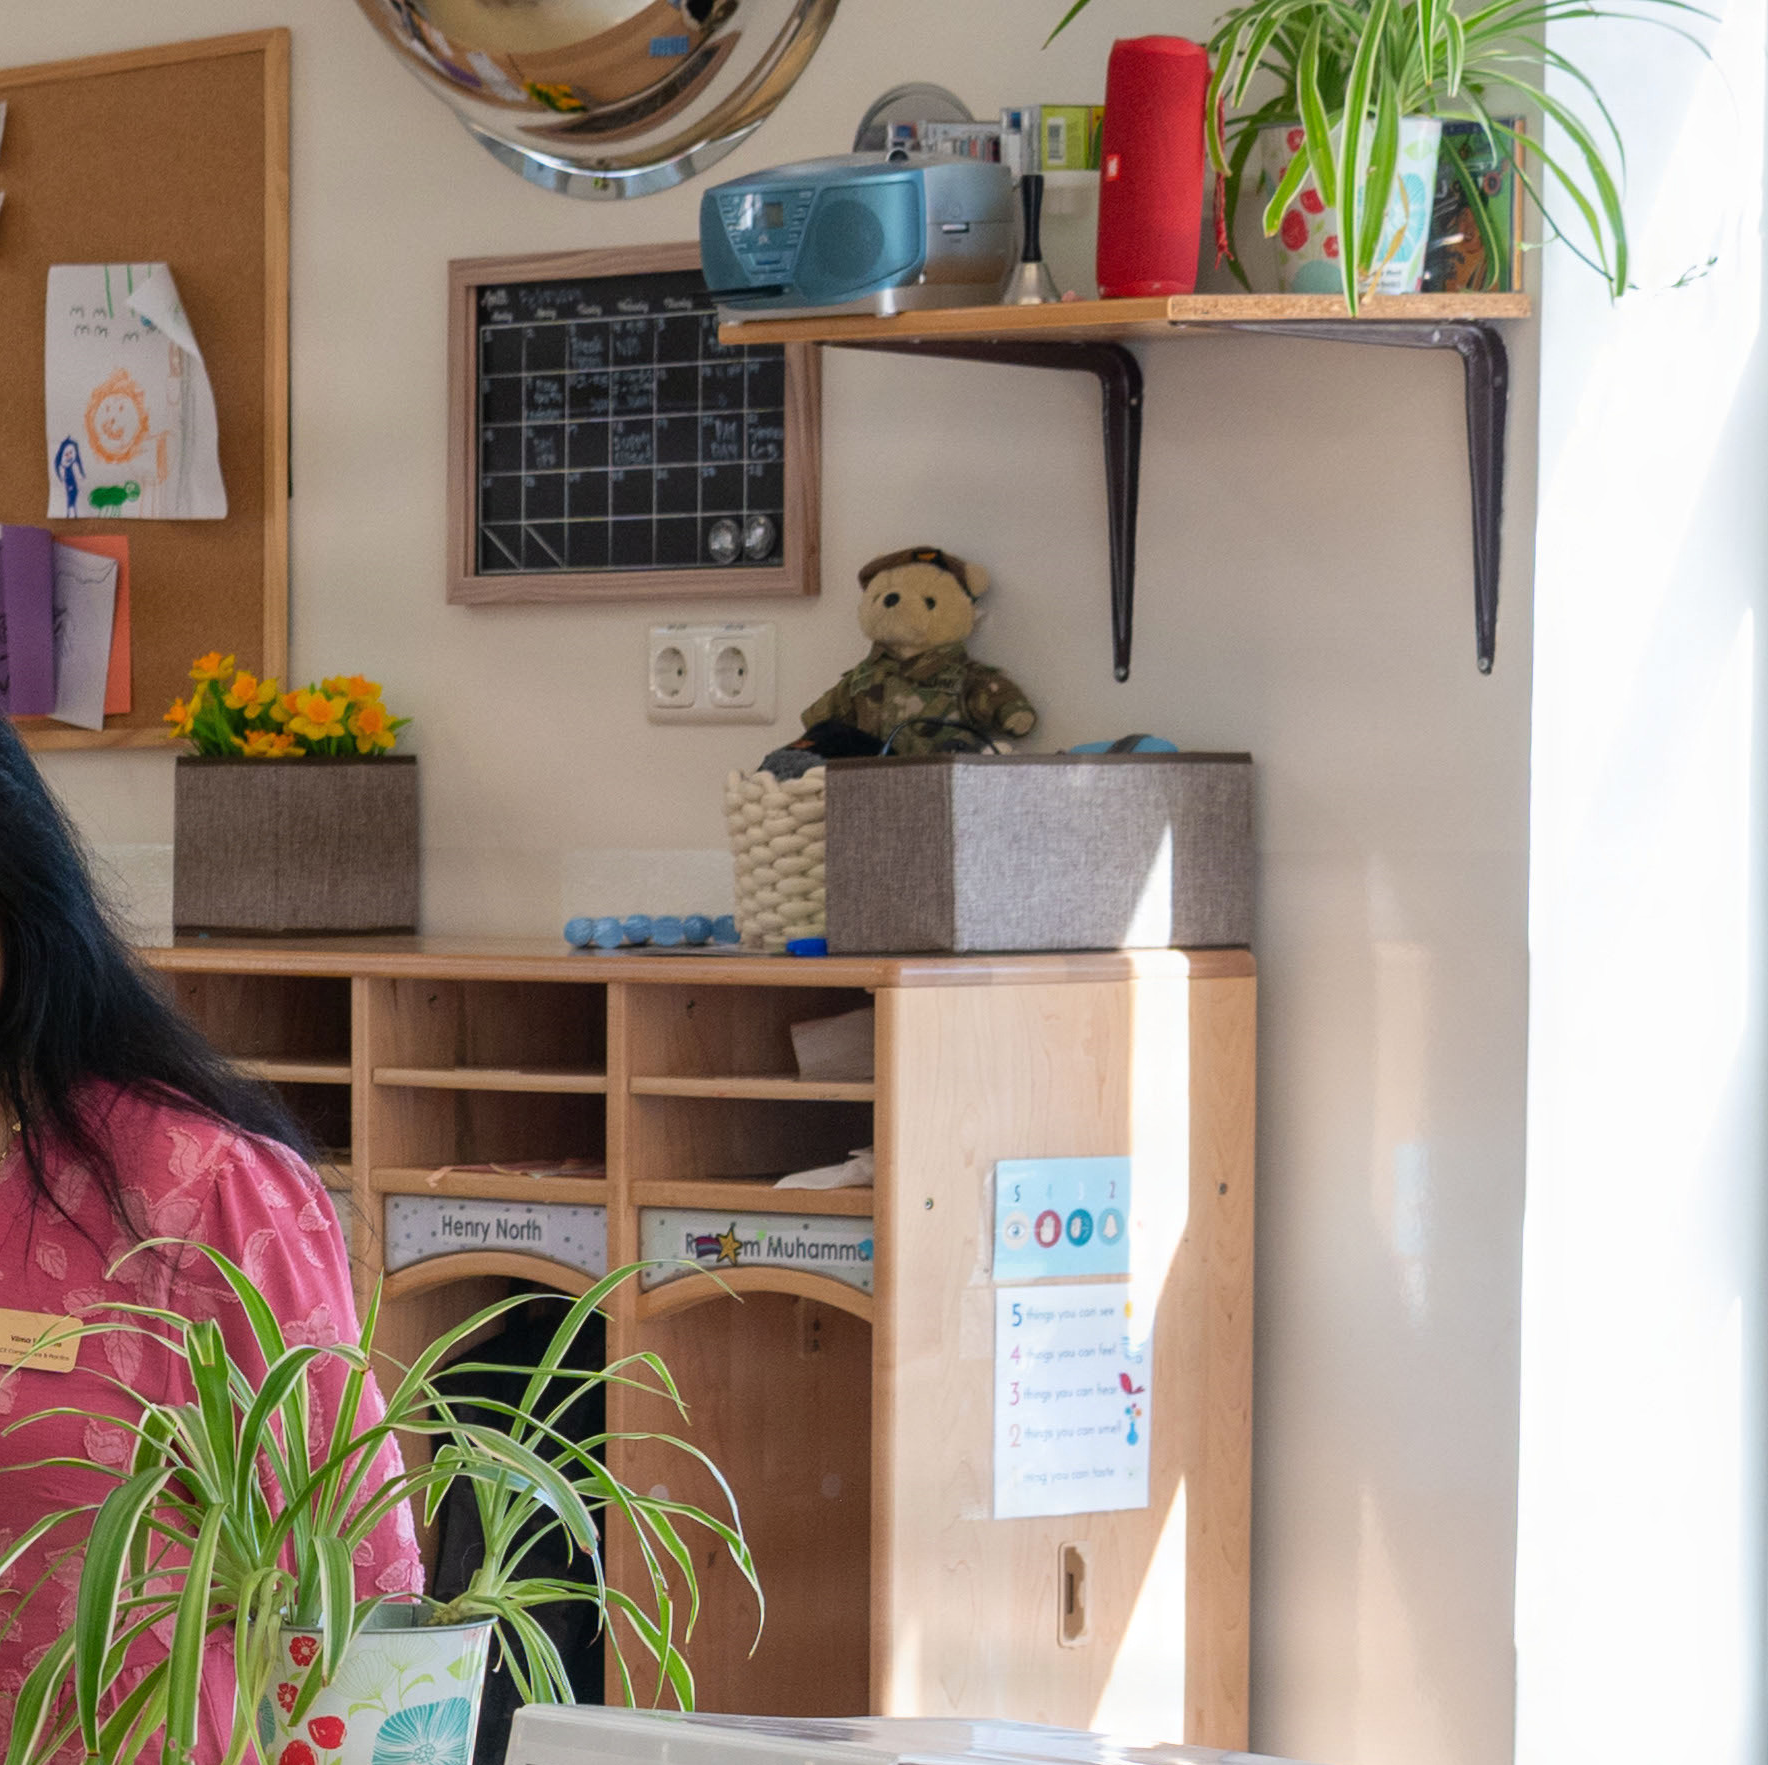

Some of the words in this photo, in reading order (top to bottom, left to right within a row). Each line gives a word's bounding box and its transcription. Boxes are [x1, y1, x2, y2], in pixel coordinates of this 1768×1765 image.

[441, 1215, 490, 1243] Henry
[496, 1215, 542, 1241] North
[1012, 1303, 1022, 1327] 5
[1026, 1308, 1057, 1322] things
[1059, 1309, 1076, 1320] you
[1079, 1307, 1097, 1318] can
[1100, 1307, 1114, 1317] see
[1010, 1345, 1021, 1365] 4
[1058, 1346, 1076, 1359] you
[1079, 1345, 1096, 1357] can
[1098, 1343, 1116, 1355] feel
[1009, 1381, 1020, 1406] 3
[1023, 1385, 1054, 1403] things
[1056, 1386, 1074, 1400] you
[1076, 1385, 1094, 1396] can
[1009, 1423, 1022, 1447] 2
[1024, 1427, 1054, 1442] things
[1056, 1426, 1075, 1439] you
[1077, 1425, 1095, 1436] can
[1098, 1420, 1122, 1434] smell
[1051, 1469, 1070, 1481] you
[1071, 1468, 1089, 1479] can
